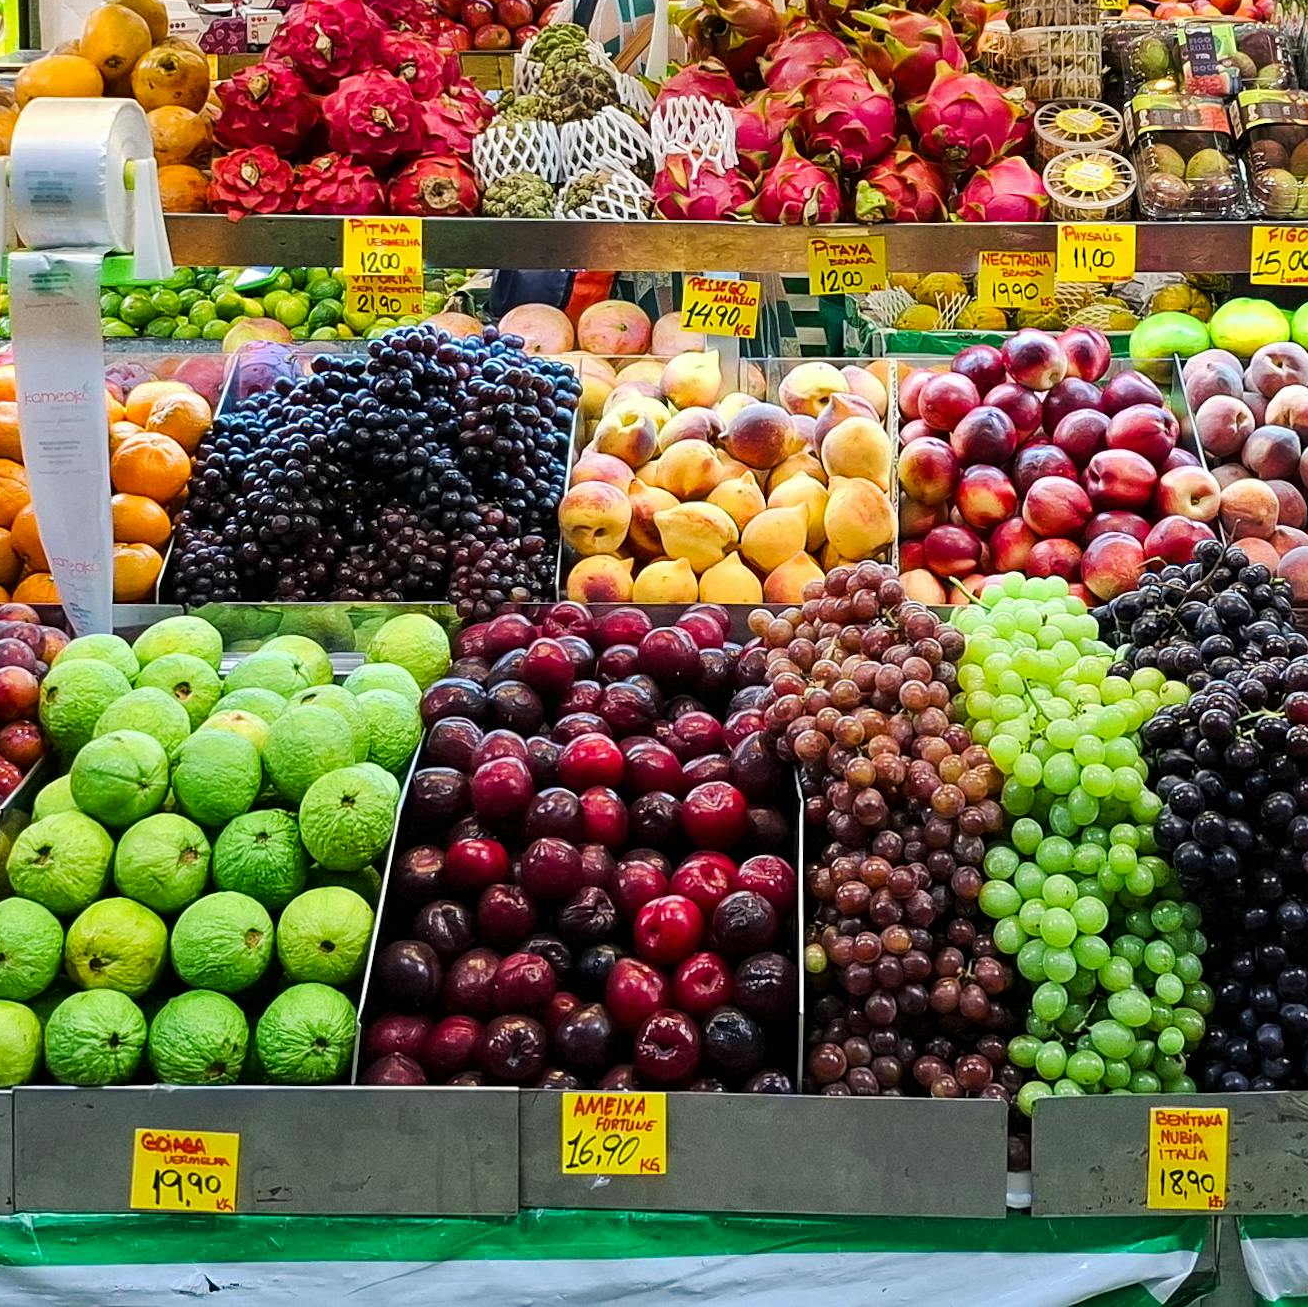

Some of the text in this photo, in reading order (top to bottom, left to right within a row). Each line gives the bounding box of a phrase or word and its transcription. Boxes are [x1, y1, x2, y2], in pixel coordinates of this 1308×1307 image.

[348, 219, 410, 235] PITAYA
[1268, 227, 1308, 243] FIGO
[811, 240, 872, 257] PITAYA
[829, 256, 877, 266] BRANCA
[982, 251, 1051, 268] NECTARINA
[1074, 247, 1115, 273] 11,00
[357, 294, 402, 316] 21,90
[712, 293, 757, 307] AMARELO
[734, 323, 751, 337] KG
[574, 1095, 646, 1118] AMEIXA
[595, 1117, 658, 1132] FORTUNE
[1156, 1111, 1223, 1128] BENITAKA
[566, 1130, 640, 1169] 16,90
[640, 1157, 660, 1173] KG
[153, 1169, 221, 1207] 19,90
[1160, 1168, 1215, 1200] 18,90
